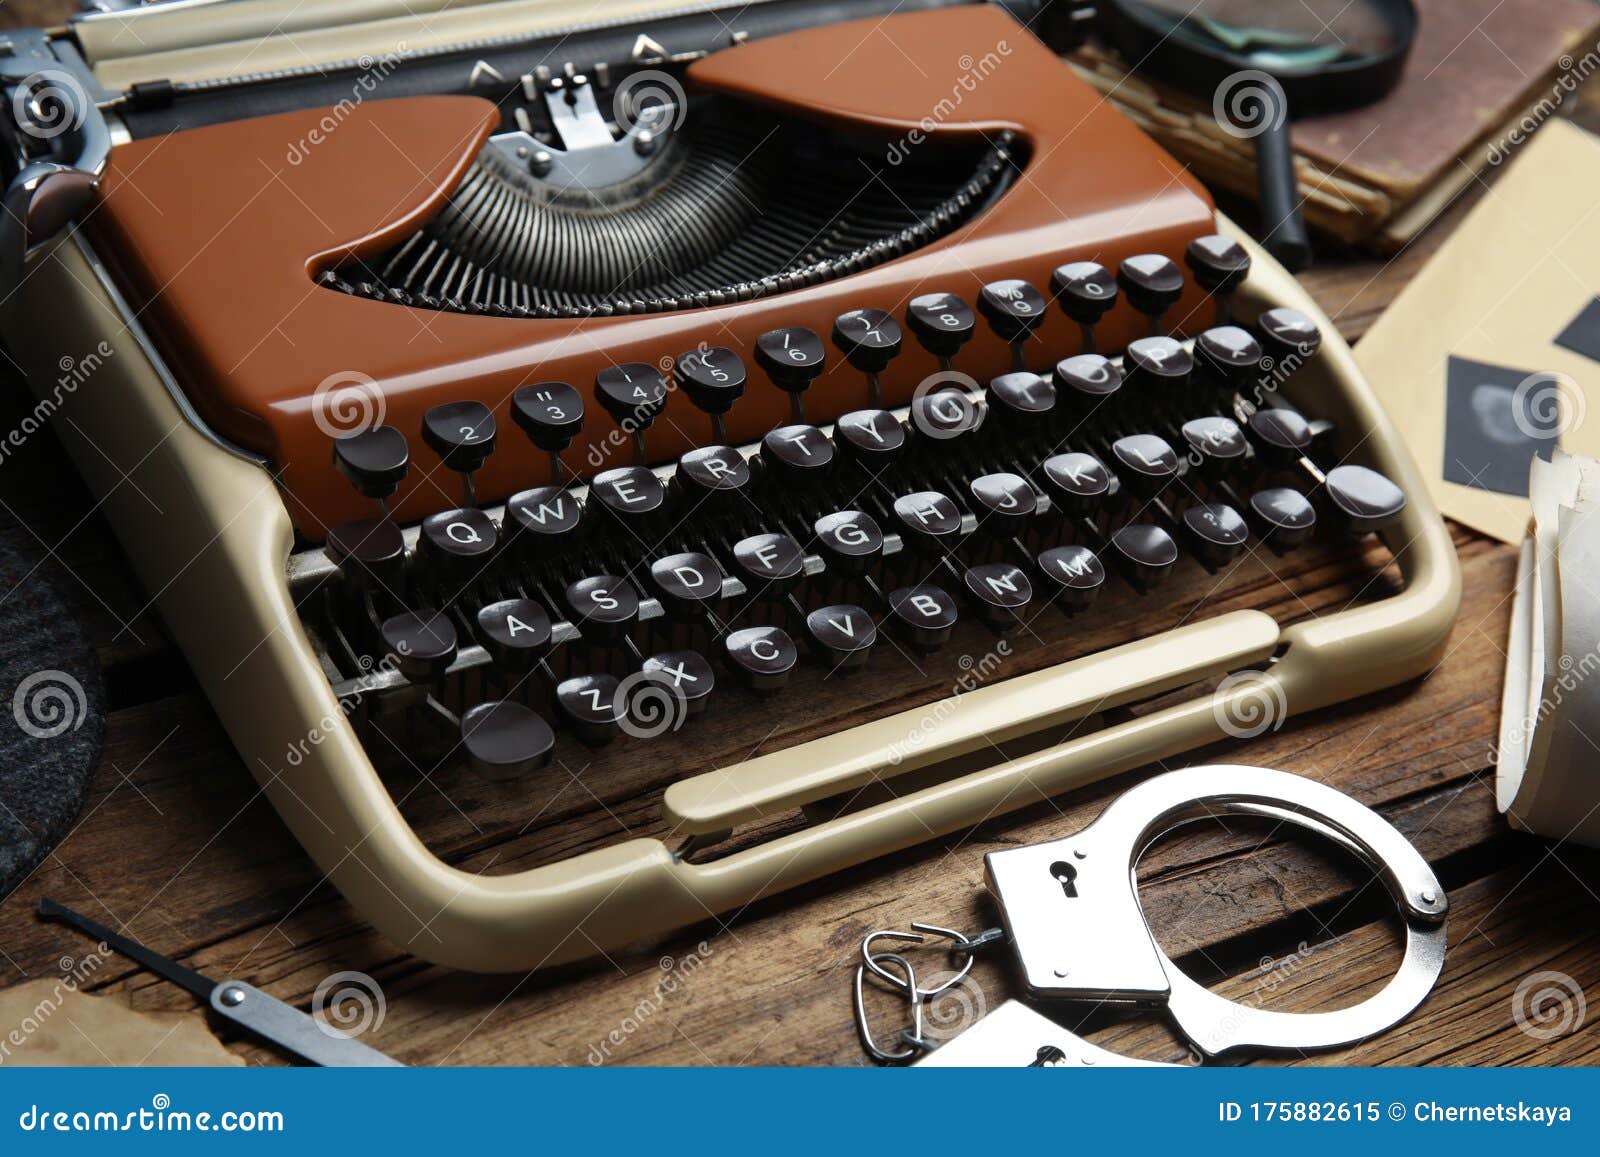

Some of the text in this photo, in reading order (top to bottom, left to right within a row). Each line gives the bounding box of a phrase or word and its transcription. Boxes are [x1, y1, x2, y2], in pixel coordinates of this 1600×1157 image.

[1013, 301, 1032, 313] 9
[940, 314, 960, 326] 8
[867, 330, 882, 342] 7
[788, 349, 807, 362] 6
[710, 369, 729, 382] 5
[633, 386, 648, 398] 4
[547, 406, 565, 420] 3
[931, 400, 964, 423] U
[459, 426, 479, 441] 2
[853, 421, 885, 443] Y
[785, 434, 812, 456] T
[1133, 448, 1164, 466] L
[702, 458, 737, 479] R
[1064, 465, 1097, 486] K
[612, 479, 647, 503] E
[1000, 487, 1019, 509] J
[521, 498, 564, 525] W
[912, 502, 946, 525] H
[446, 522, 482, 543] Q
[834, 523, 870, 545] G
[754, 544, 778, 569] F
[1056, 554, 1093, 578] M
[673, 566, 704, 588] D
[985, 575, 1018, 595] N
[590, 589, 619, 610] S
[911, 595, 942, 617] B
[506, 614, 536, 637] A
[828, 615, 855, 637] V
[750, 639, 779, 660] C
[662, 661, 698, 687] X
[579, 688, 613, 711] Z
